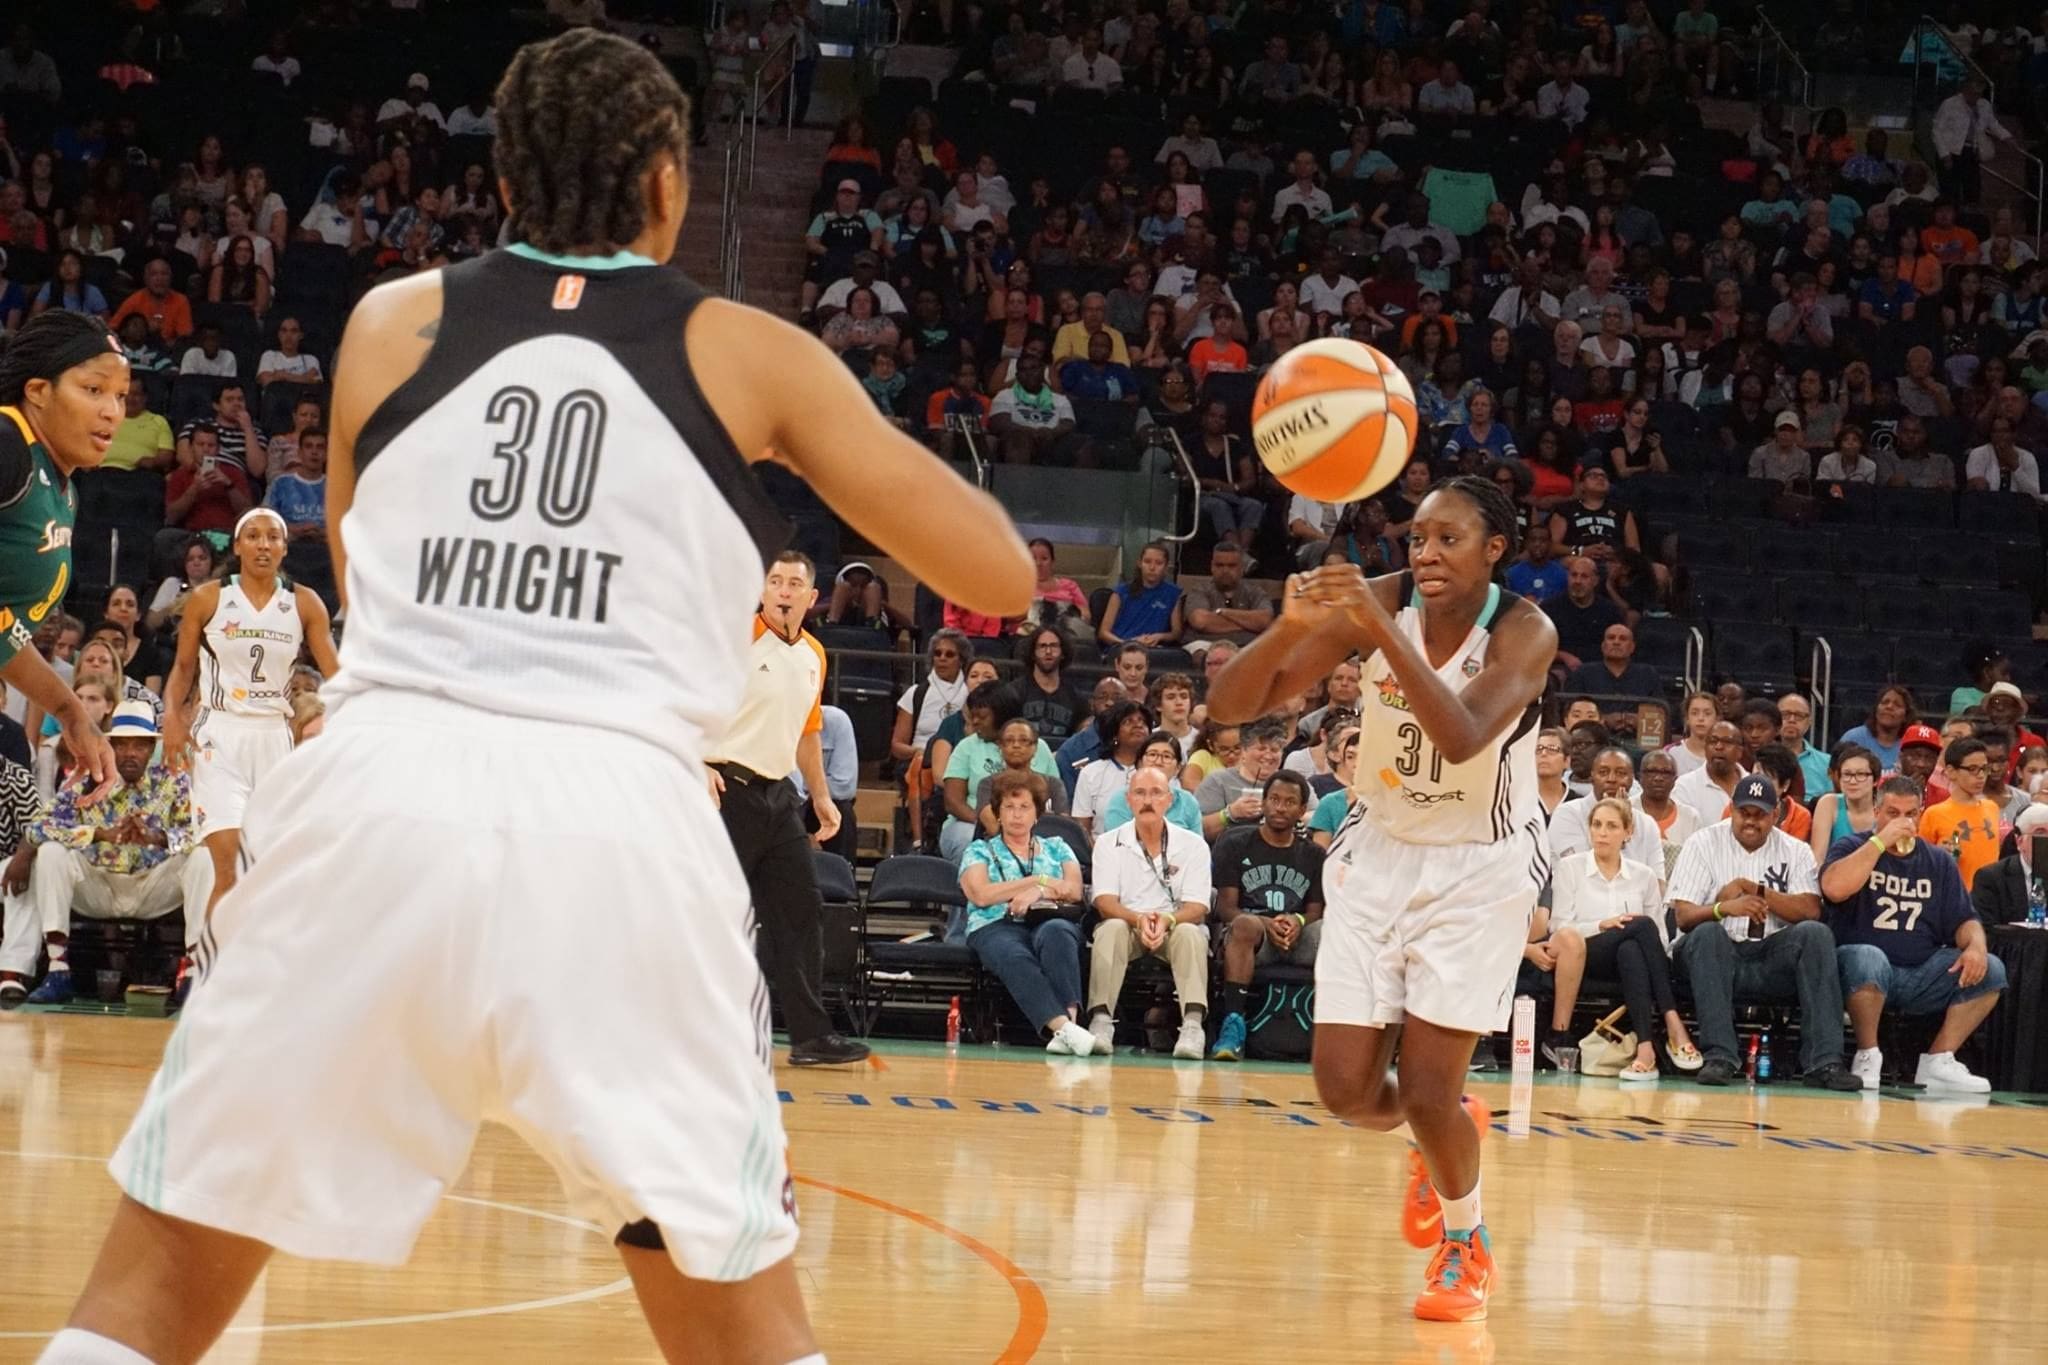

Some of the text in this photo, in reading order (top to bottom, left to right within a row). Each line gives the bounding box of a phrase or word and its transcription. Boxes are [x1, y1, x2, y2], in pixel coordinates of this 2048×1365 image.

[1257, 398, 1329, 455] SPALDIN
[469, 385, 607, 528] 30
[416, 537, 623, 623] WRIGHT
[250, 644, 266, 683] 2
[1642, 719, 1662, 734] 1-2
[1395, 722, 1443, 784] 31
[1241, 864, 1311, 900] NEW YORK
[1265, 890, 1285, 911] 10
[1869, 870, 1932, 899] POLO
[1873, 896, 1923, 931] 27
